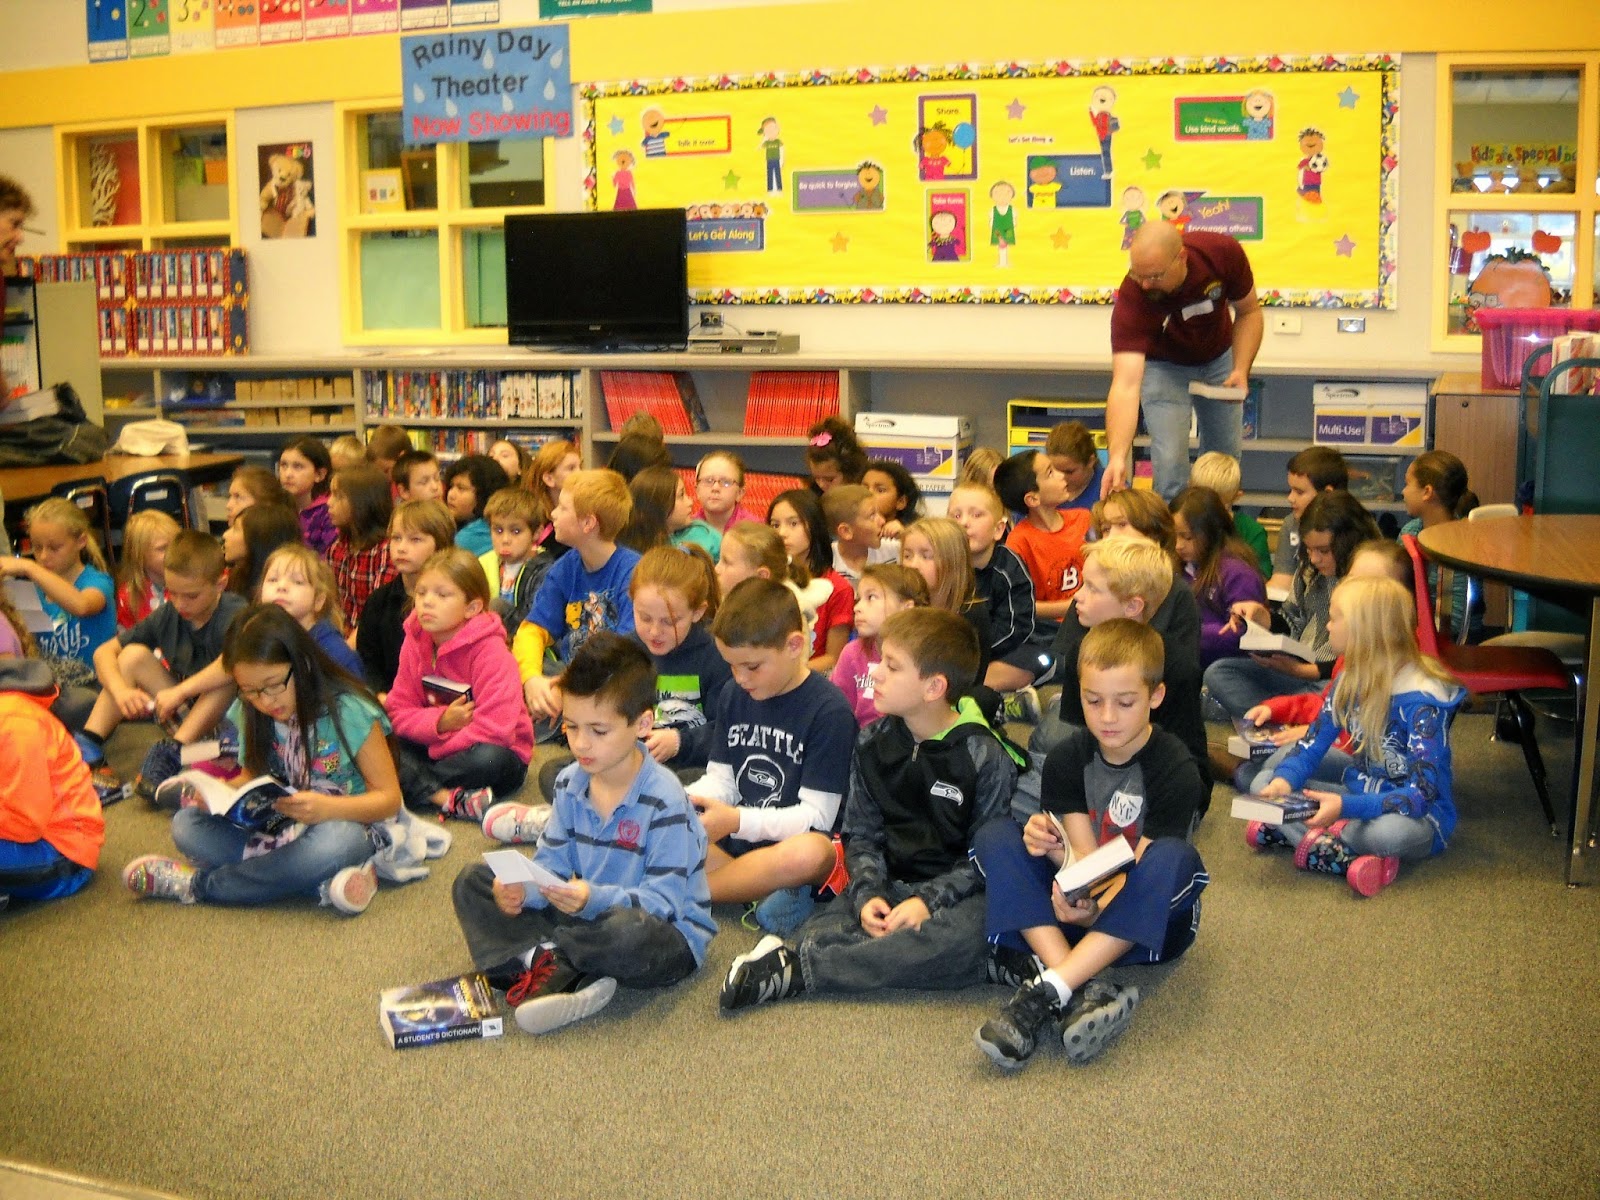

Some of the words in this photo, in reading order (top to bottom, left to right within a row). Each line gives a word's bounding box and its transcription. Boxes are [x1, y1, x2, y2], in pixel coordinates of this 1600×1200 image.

[412, 33, 486, 70] Rainy
[497, 31, 551, 61] Day
[431, 73, 529, 99] Theater
[412, 115, 462, 139] Now
[468, 106, 570, 136] Showing
[1185, 125, 1199, 134] Use
[1200, 124, 1216, 133] kind
[809, 182, 826, 191] quick
[827, 181, 834, 189] to
[688, 230, 709, 241] Let's
[710, 230, 726, 240] Get
[728, 228, 755, 242] Along
[1319, 424, 1361, 436] Multi-Use
[1061, 566, 1078, 591] B
[727, 723, 804, 765] SEATTLE
[1111, 795, 1133, 820] NYC
[404, 1032, 440, 1044] STUDENT'S
[441, 1026, 482, 1038] DICTIONARY
